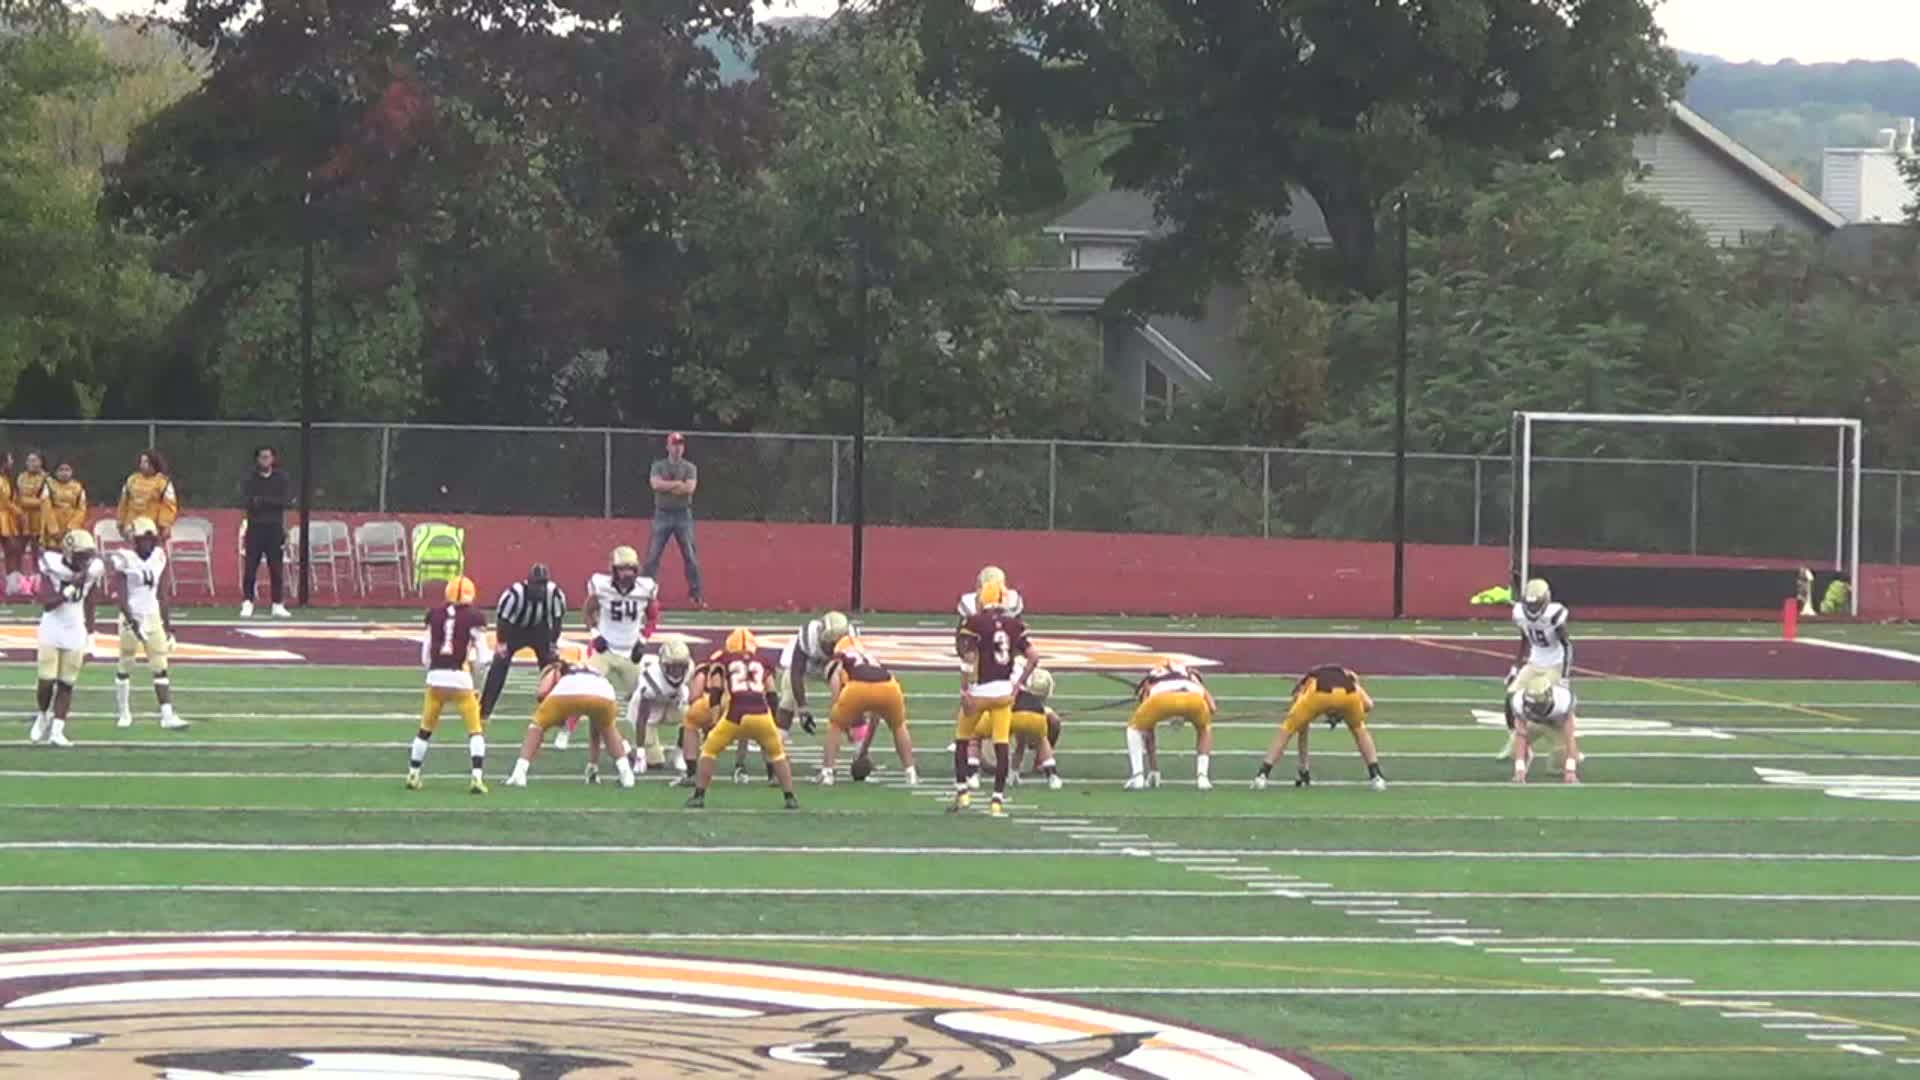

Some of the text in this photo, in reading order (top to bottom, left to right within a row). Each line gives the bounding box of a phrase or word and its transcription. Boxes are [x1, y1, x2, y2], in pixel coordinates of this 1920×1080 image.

[610, 600, 638, 621] 54
[440, 618, 455, 655] 1
[993, 630, 1010, 665] 3
[728, 660, 765, 692] 23
